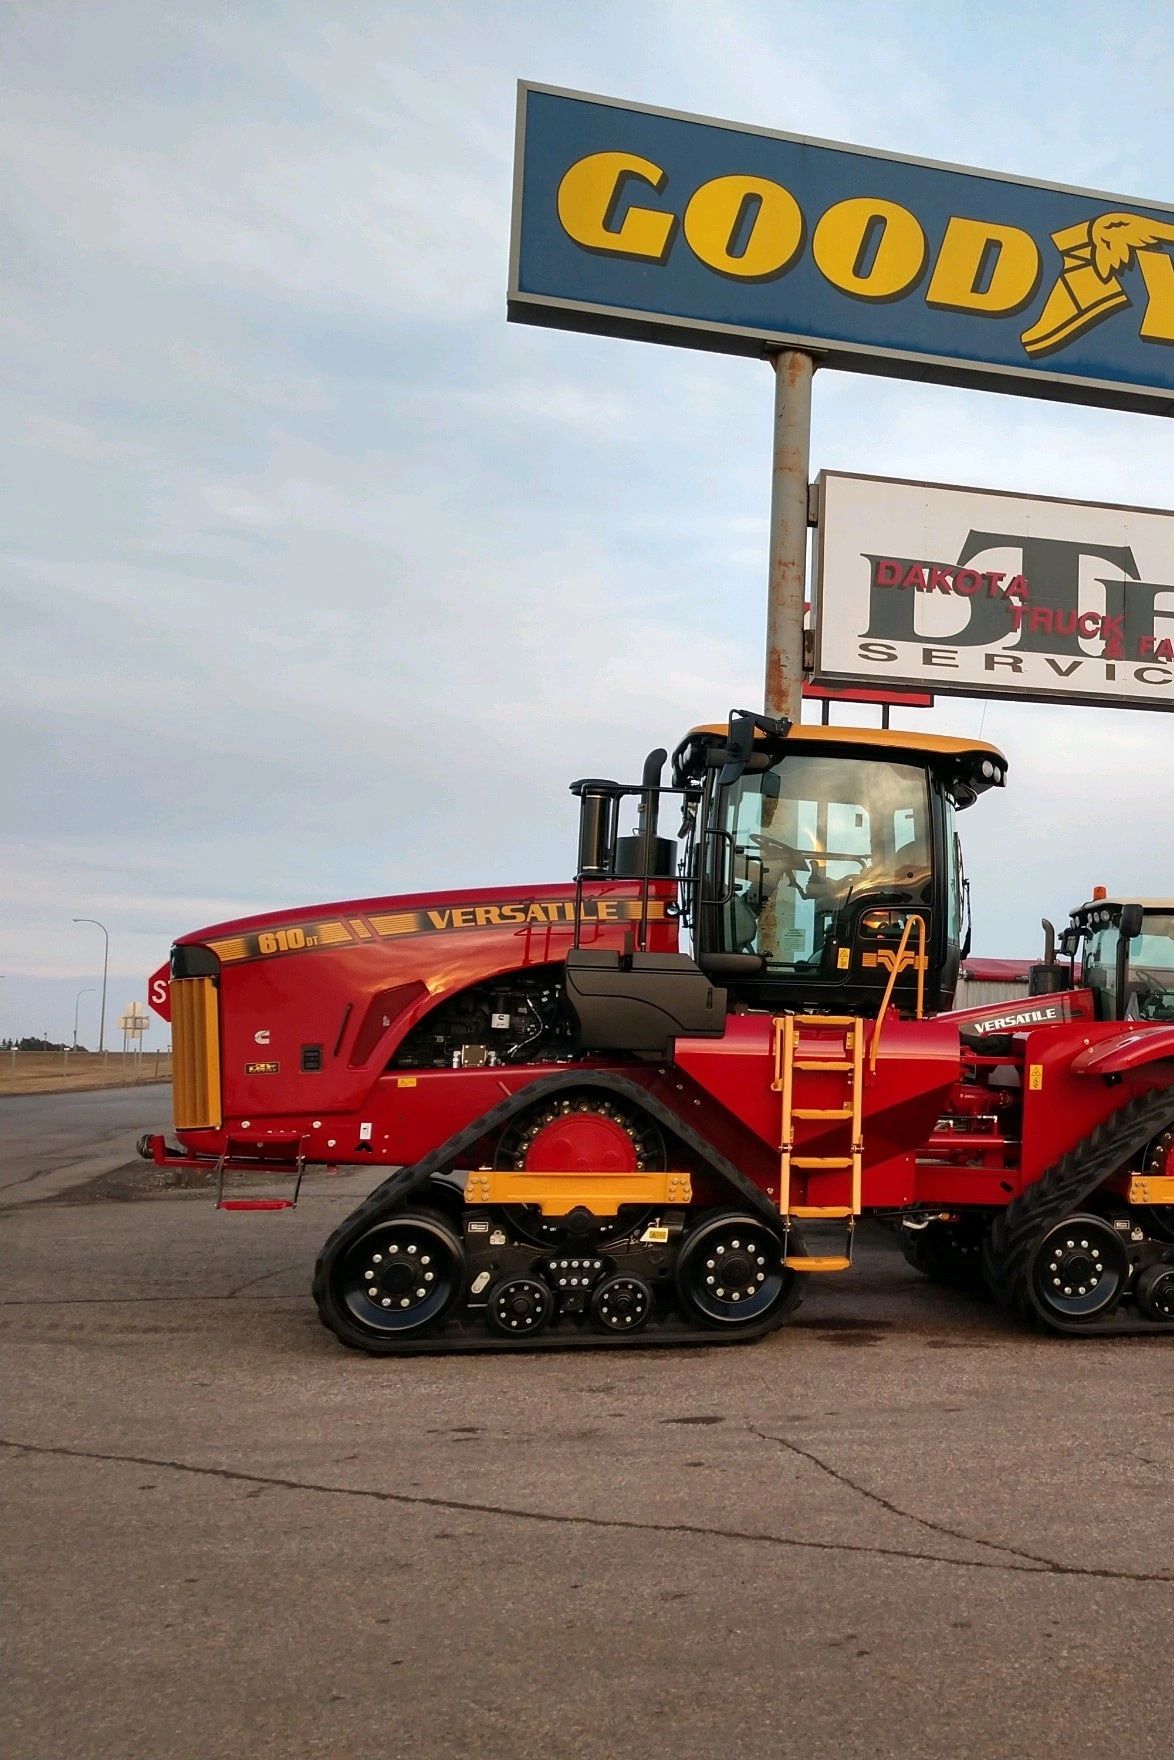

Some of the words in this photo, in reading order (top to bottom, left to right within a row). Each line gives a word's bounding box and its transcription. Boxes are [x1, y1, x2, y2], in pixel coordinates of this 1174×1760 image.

[874, 560, 1031, 602] DAKOTA
[1006, 605, 1127, 641] TRUCK
[426, 900, 619, 930] VERSATILE
[258, 928, 305, 954] 610
[151, 979, 171, 1004] S
[973, 1008, 1057, 1034] VERSATILE
